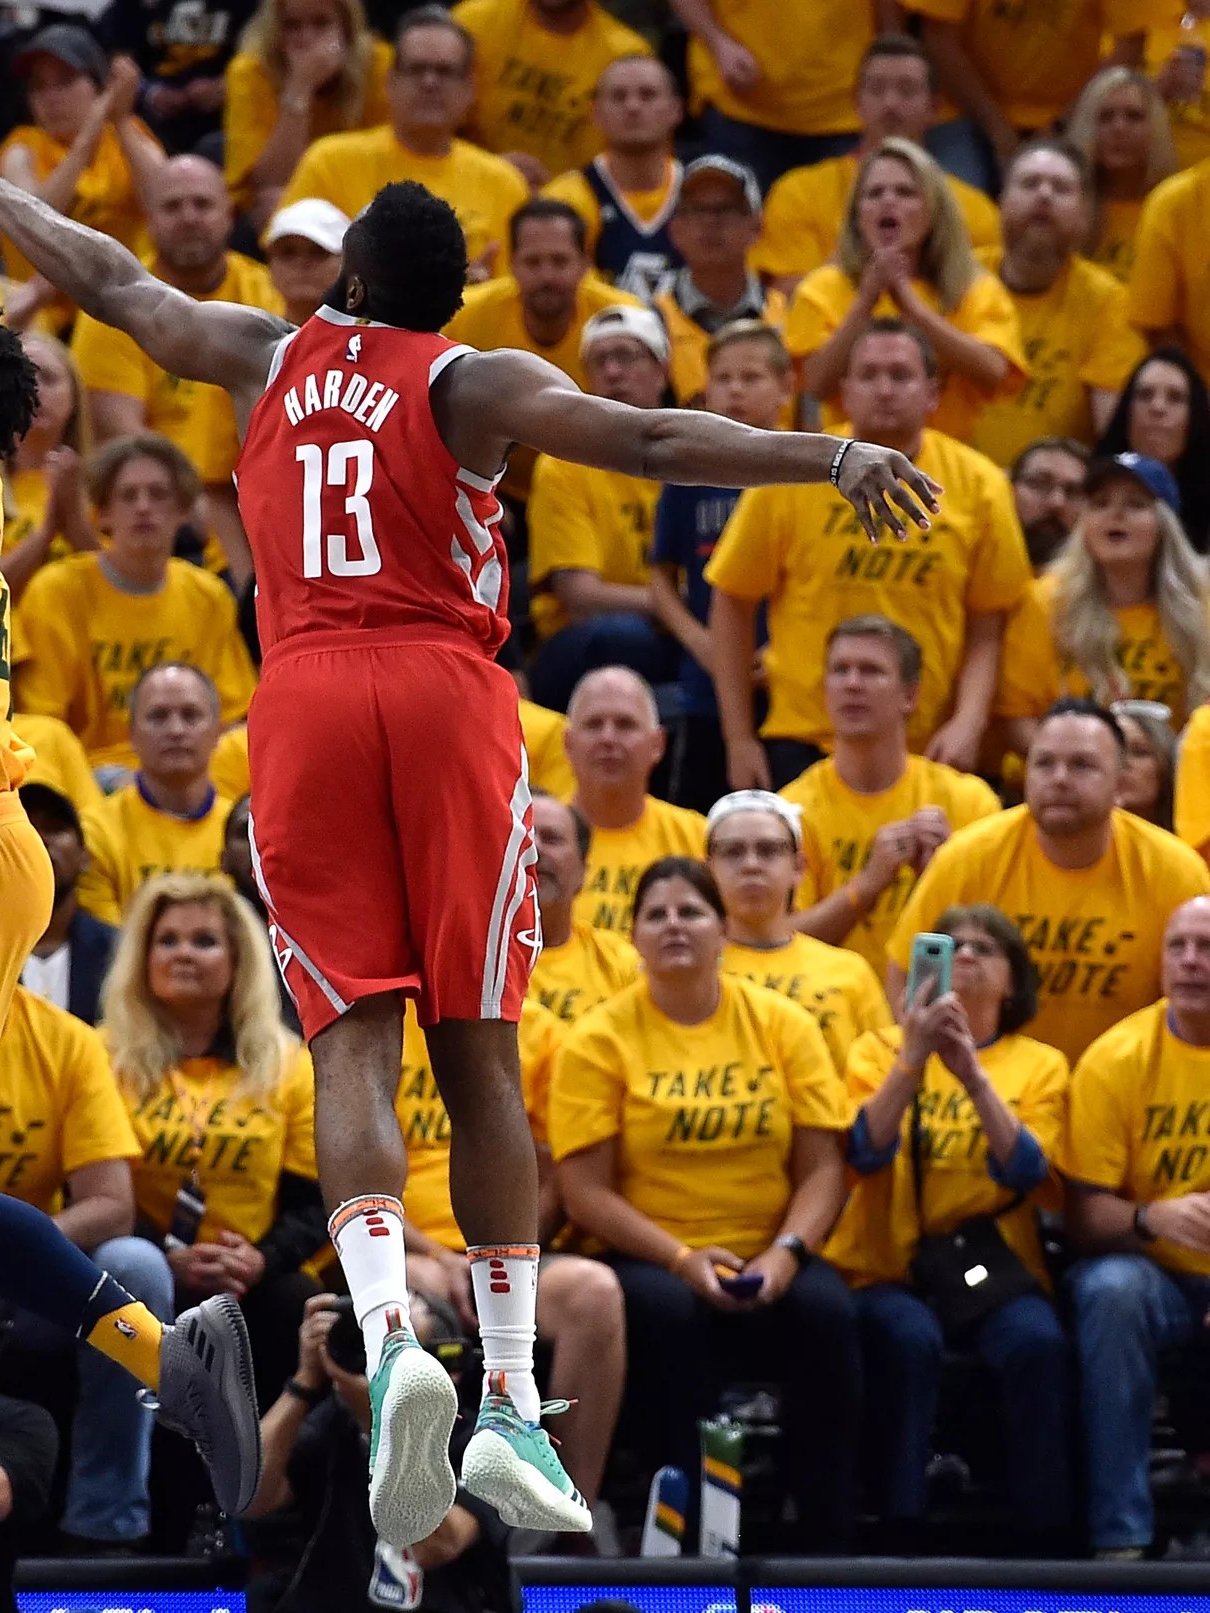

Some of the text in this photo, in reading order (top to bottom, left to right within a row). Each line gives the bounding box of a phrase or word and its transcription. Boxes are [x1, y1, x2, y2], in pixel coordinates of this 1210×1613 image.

[284, 369, 400, 433] HARDEN
[295, 439, 381, 579] 13
[835, 547, 944, 585] NOTE
[647, 1061, 740, 1098] TAKE
[664, 1097, 776, 1141] NOTE
[1141, 1101, 1210, 1143] TAK
[144, 1129, 263, 1172] NOTE
